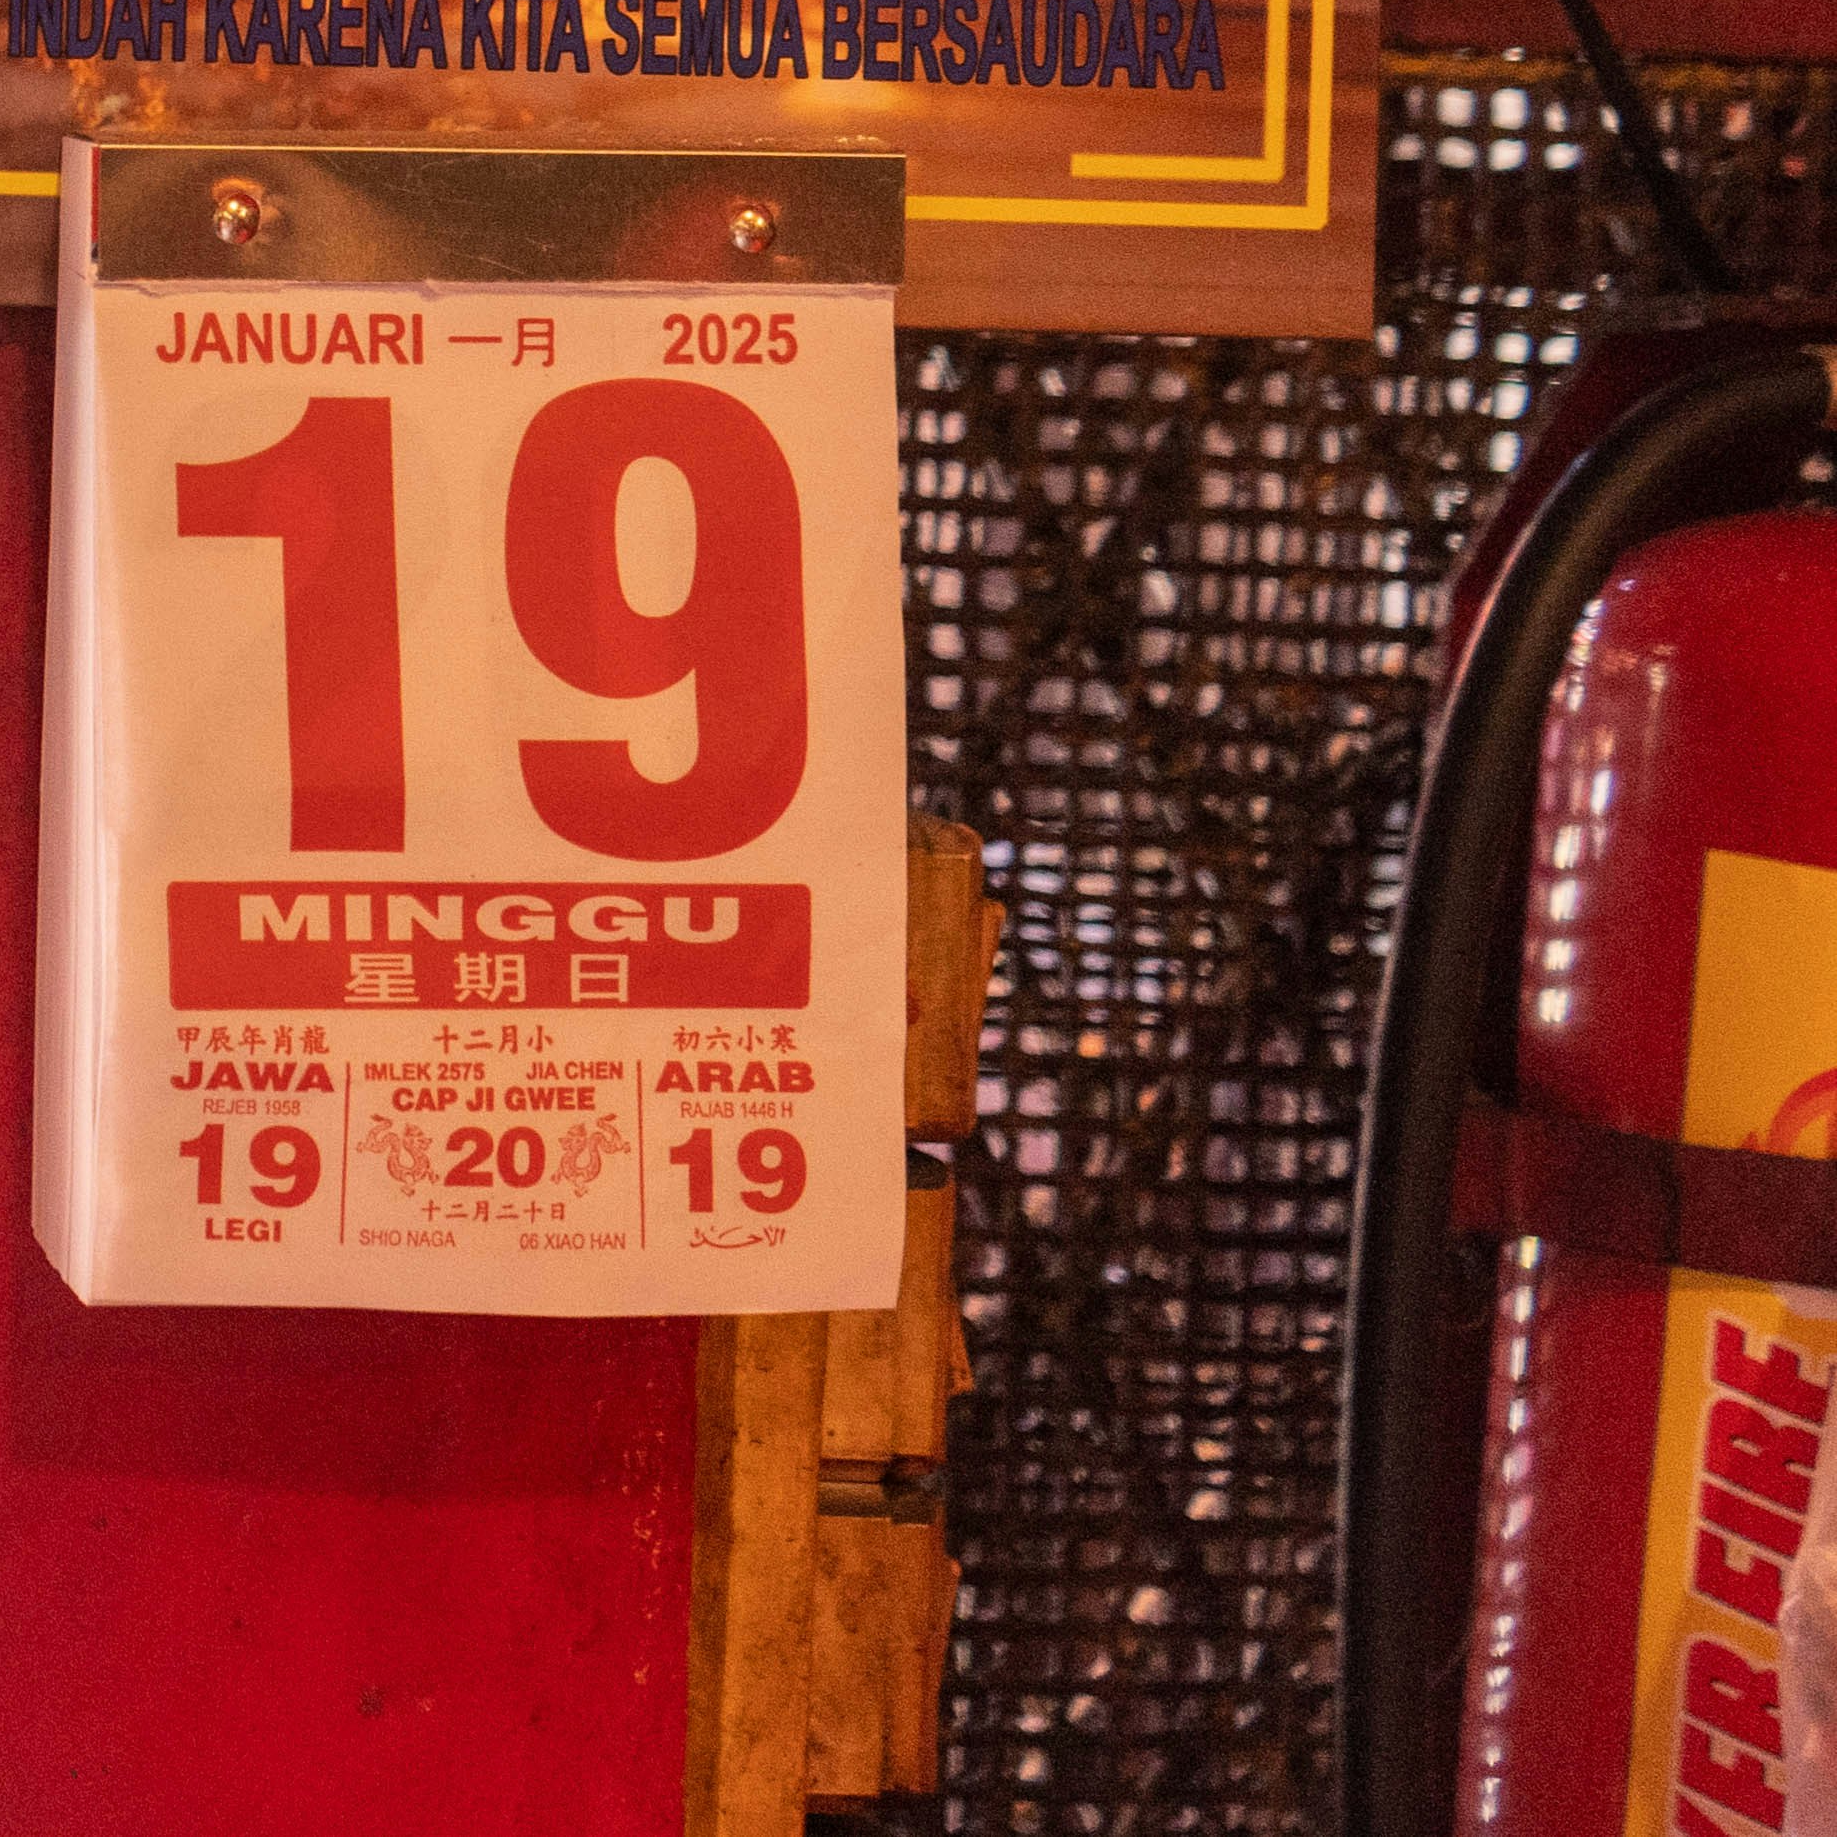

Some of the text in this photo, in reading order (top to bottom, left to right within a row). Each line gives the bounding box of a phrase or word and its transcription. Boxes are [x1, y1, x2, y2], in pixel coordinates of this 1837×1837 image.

[156, 312, 799, 368] JANUARI 一月 2025
[175, 377, 809, 863] 19
[239, 894, 740, 943] MINGGU
[343, 952, 629, 1003] 星期日
[432, 1024, 554, 1056] 十二月小
[673, 1024, 799, 1056] 初六小寒
[170, 1061, 335, 1093] JAWA
[364, 1063, 486, 1082] IMLEK 2575
[526, 1061, 624, 1080] JIA CHEN
[655, 1061, 816, 1094] ARAB
[202, 1098, 257, 1115] REJEB
[392, 1086, 596, 1113] CAP JI GWEE
[680, 1101, 793, 1119] RAJAB 1446 H
[178, 1123, 321, 1208] 19
[443, 1126, 546, 1189] 20
[669, 1127, 808, 1214] 19
[421, 1199, 566, 1224] 十二月二十日
[204, 1217, 282, 1243] LEGI
[359, 1229, 456, 1248] SHIO NAGA
[518, 1232, 626, 1250] 06 XIAO HAN
